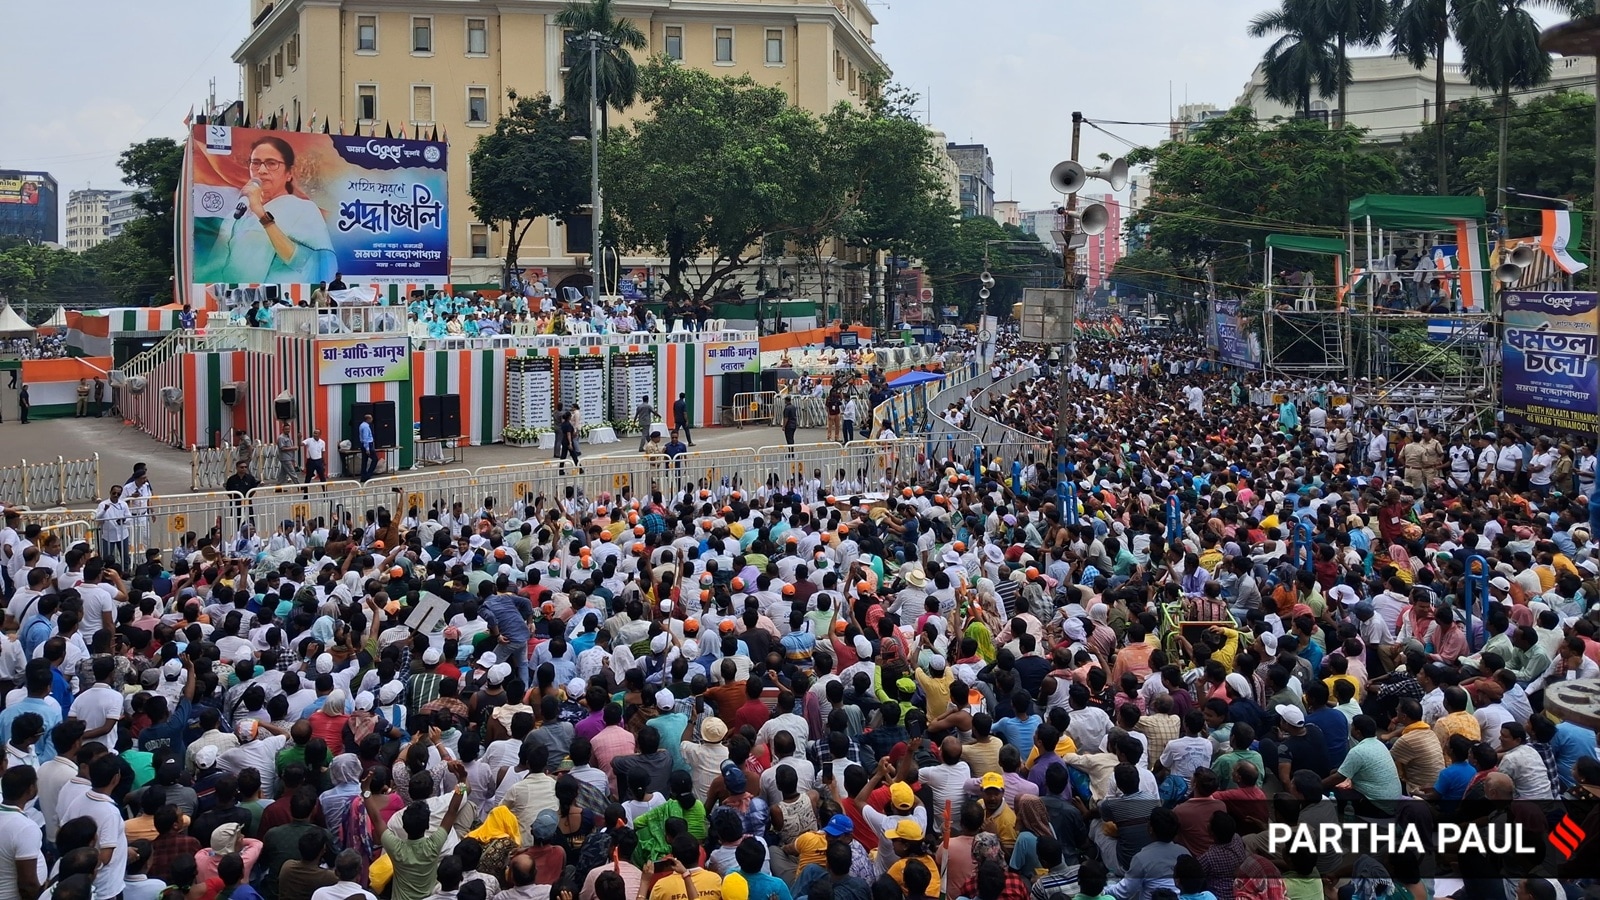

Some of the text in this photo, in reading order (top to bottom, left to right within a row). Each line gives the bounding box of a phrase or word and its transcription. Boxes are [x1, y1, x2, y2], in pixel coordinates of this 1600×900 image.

[338, 183, 443, 234] শ্রদ্ধাঞ্জলি
[353, 249, 442, 260] মমতা বন্দ্যোপাধ্যায়
[322, 343, 405, 363] মা-মাটি-মানুষ
[708, 345, 758, 360] মা-মাটি-মানুষ
[720, 362, 745, 371] ধন্যবাদ
[1525, 350, 1587, 376] চলো
[344, 365, 385, 378] ধন্যবাদ
[1526, 404, 1545, 416] NORTH
[1545, 407, 1570, 419] KOLKATA
[1535, 416, 1552, 426] WARD
[1553, 418, 1590, 432] TRINAMOOL
